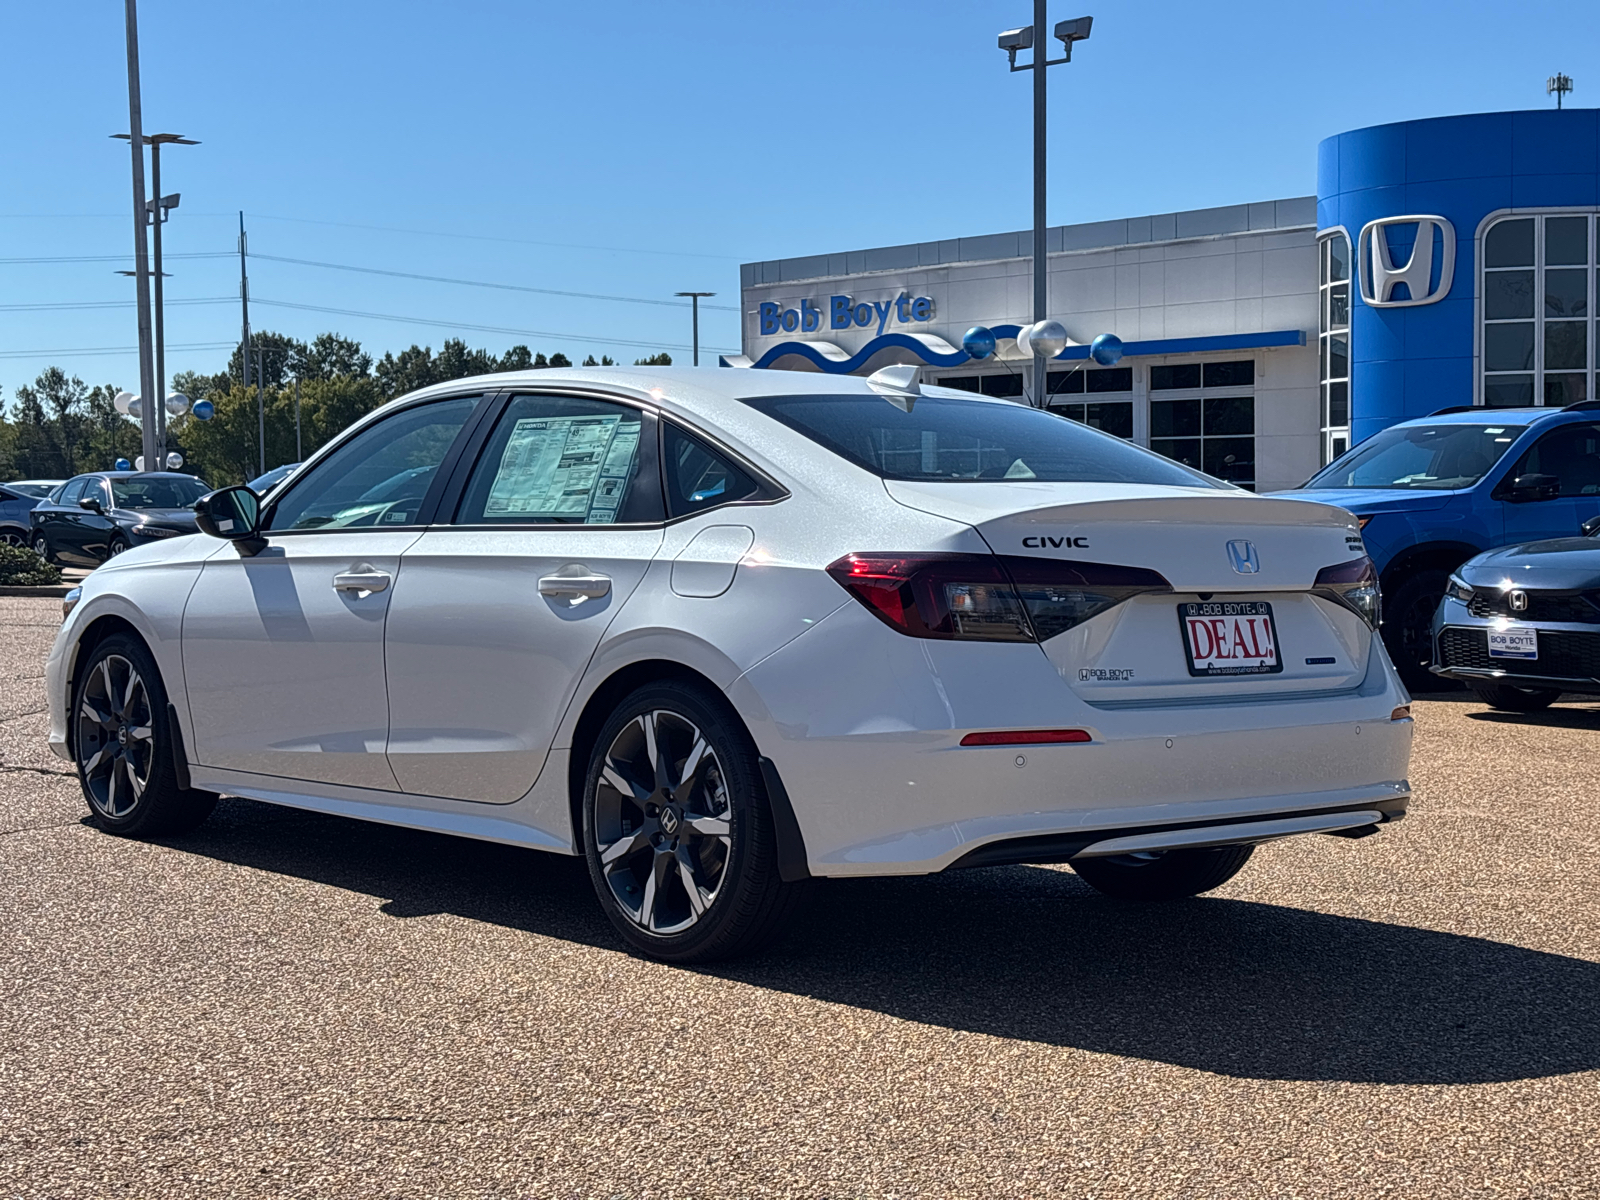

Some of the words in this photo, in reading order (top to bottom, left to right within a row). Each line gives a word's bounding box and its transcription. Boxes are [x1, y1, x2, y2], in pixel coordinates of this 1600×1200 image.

[760, 299, 820, 335] Bob
[830, 292, 932, 336] Boyte
[1022, 537, 1089, 548] CIVIC
[1203, 604, 1221, 615] BOB
[1224, 603, 1252, 615] BOYTE
[1188, 618, 1273, 659] DEAL!
[1490, 635, 1506, 644] BOB
[1509, 636, 1534, 645] BOYTE
[1090, 669, 1107, 677] BOB
[1109, 669, 1135, 677] BOYTE
